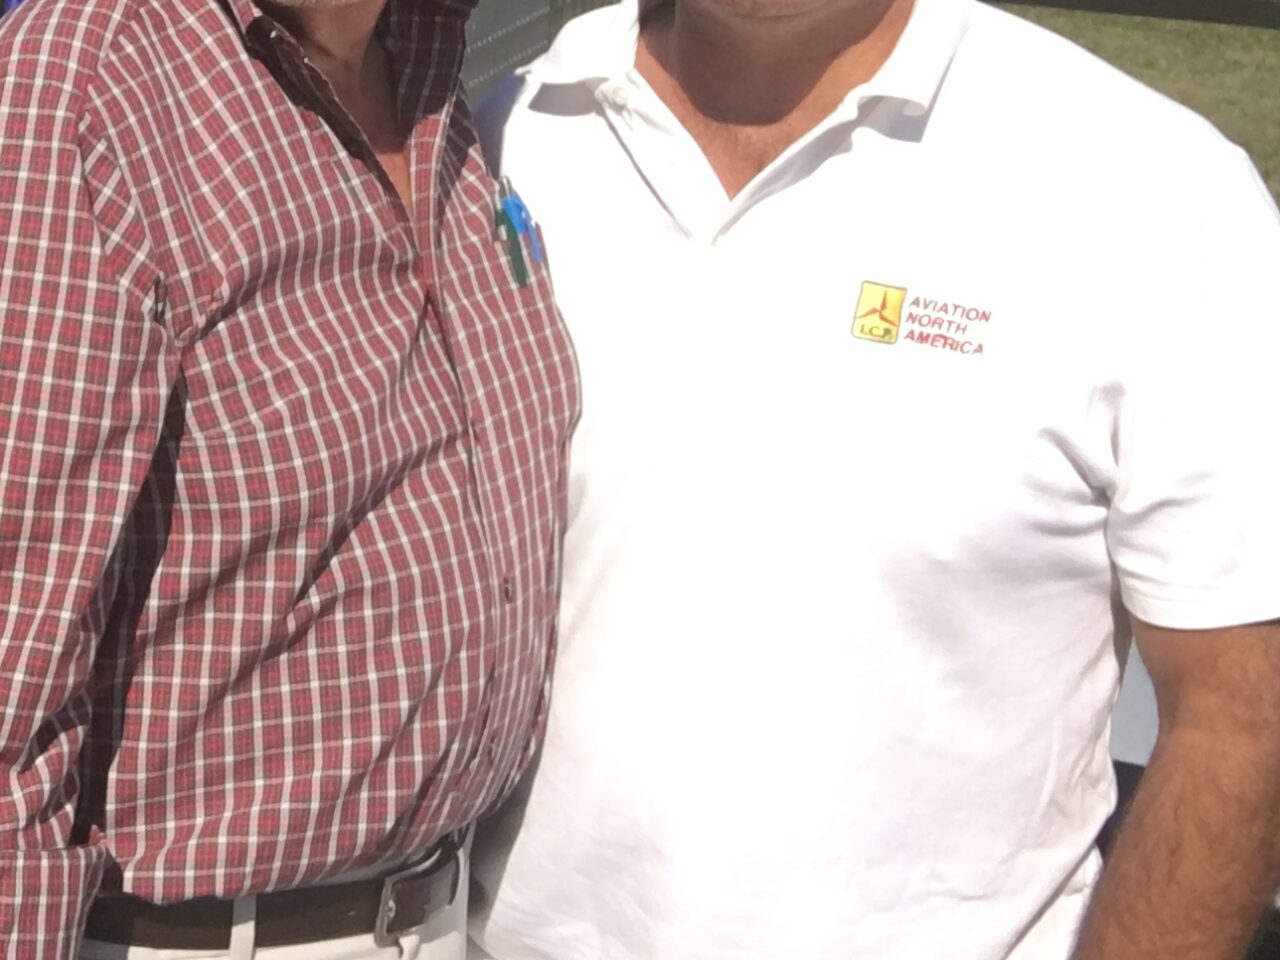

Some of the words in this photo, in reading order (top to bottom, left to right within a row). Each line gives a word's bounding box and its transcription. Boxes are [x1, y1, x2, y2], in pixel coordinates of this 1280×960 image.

[909, 296, 992, 323] AVIATION
[905, 312, 968, 335] NORTH
[903, 329, 984, 355] AMERICA
